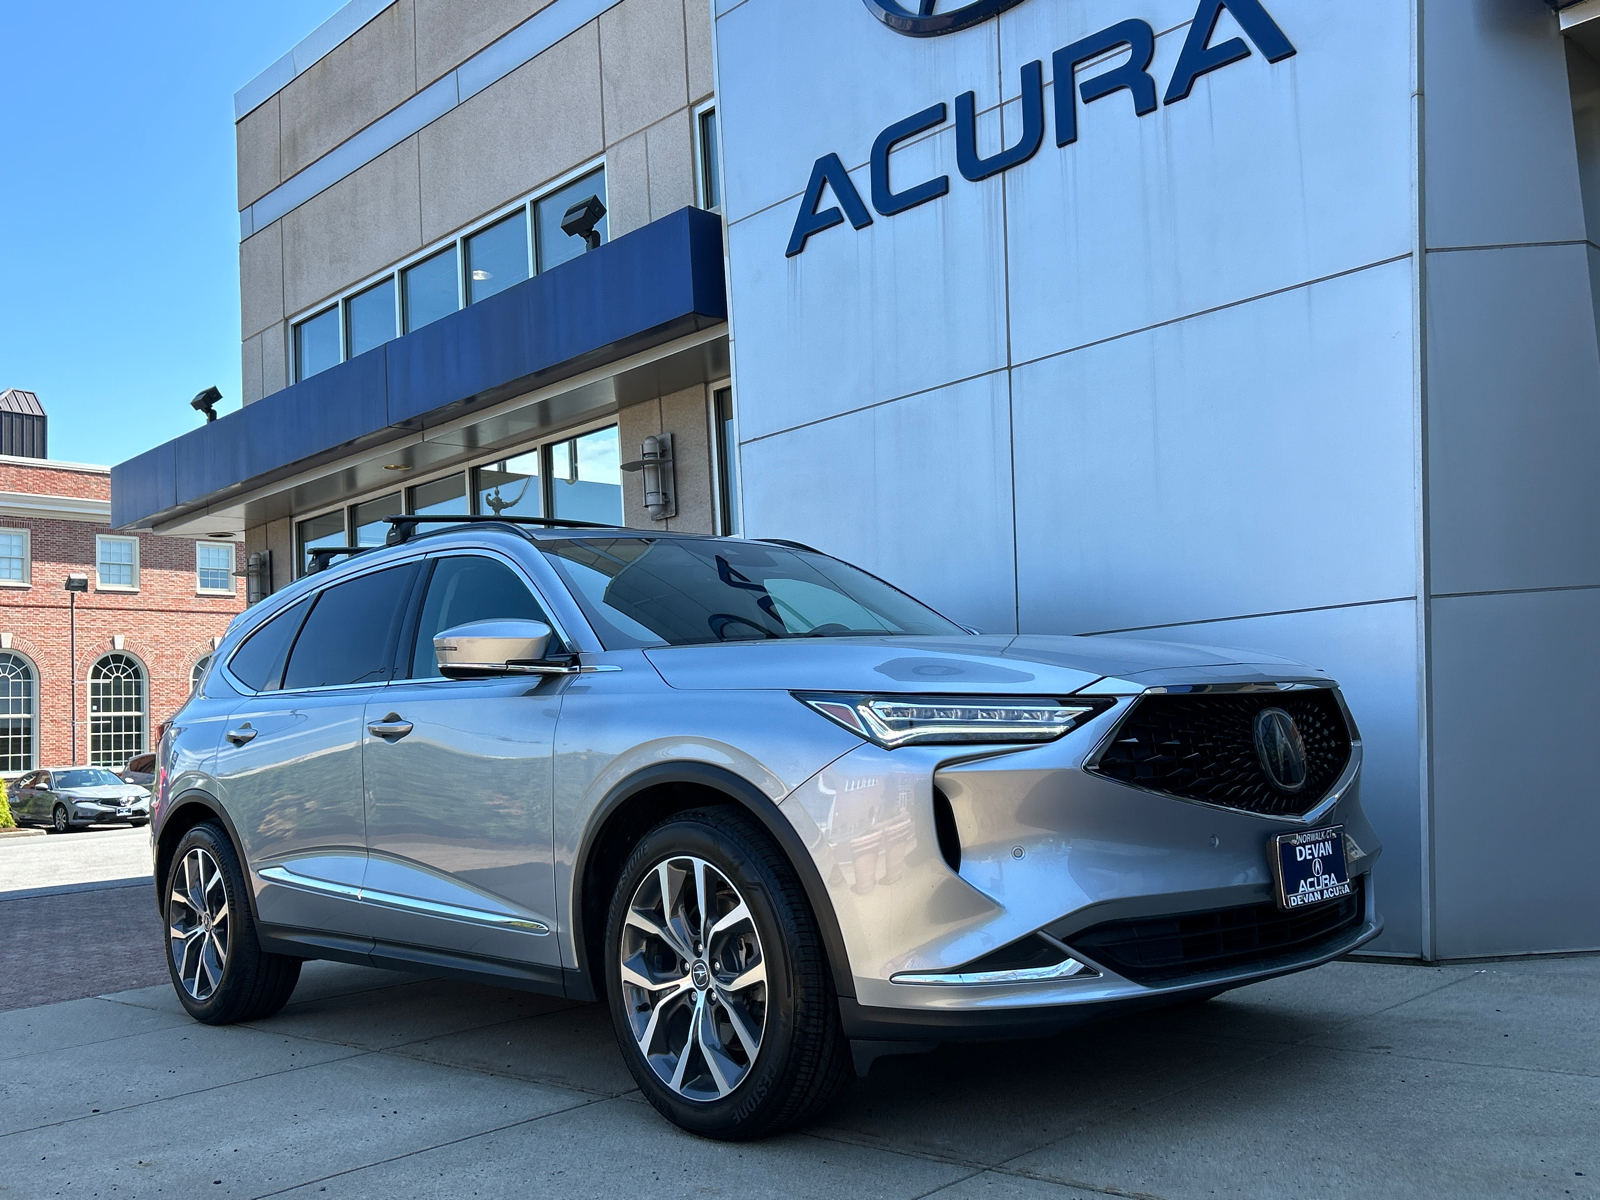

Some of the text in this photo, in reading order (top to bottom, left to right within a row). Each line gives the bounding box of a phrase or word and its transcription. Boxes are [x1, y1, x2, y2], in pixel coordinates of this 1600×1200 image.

[784, 0, 1297, 258] ACURA
[1296, 841, 1332, 861] DEVAN
[1299, 873, 1337, 892] ACURA
[1291, 891, 1321, 906] DEVAN
